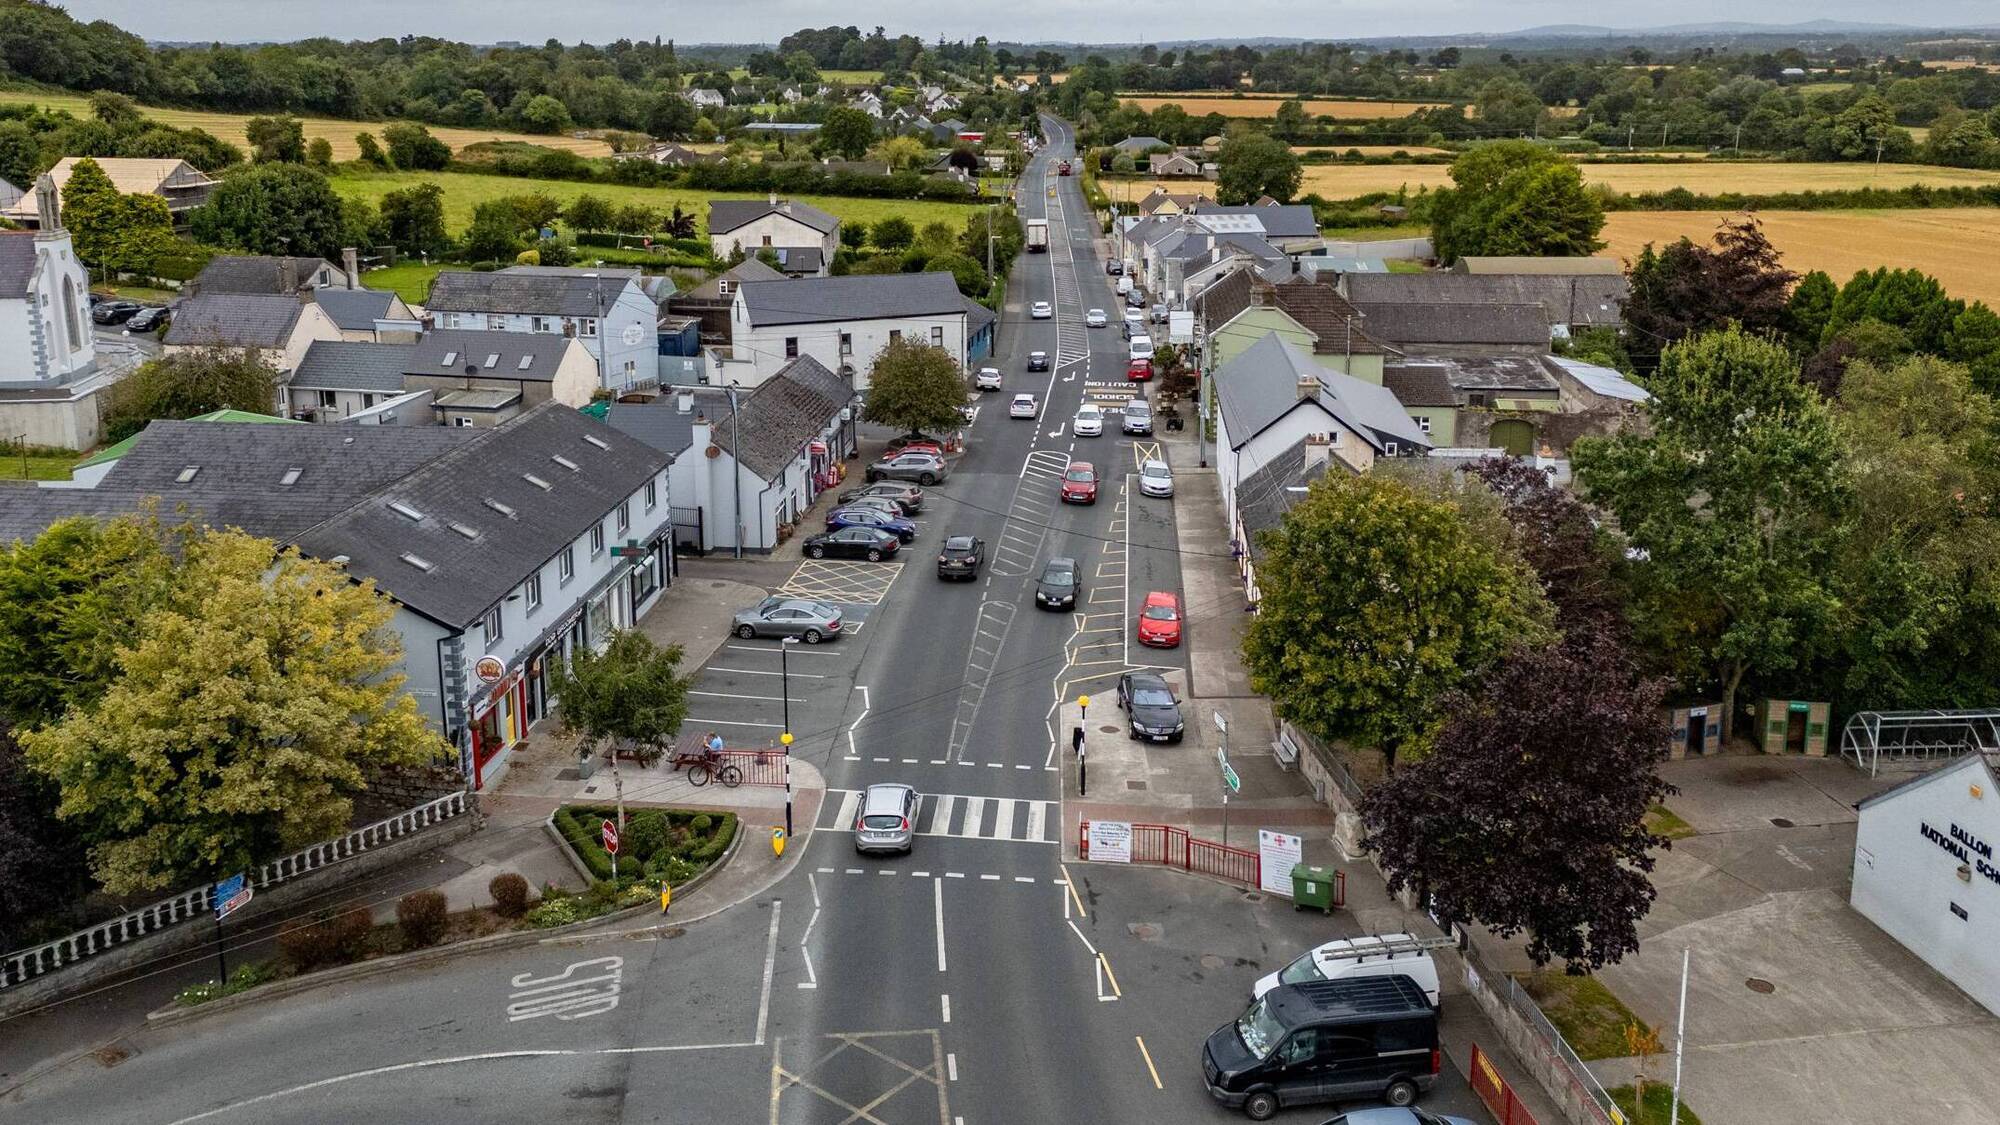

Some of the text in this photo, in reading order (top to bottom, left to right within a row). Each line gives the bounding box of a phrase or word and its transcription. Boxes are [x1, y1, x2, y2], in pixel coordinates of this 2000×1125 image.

[1921, 822, 2000, 885] NATIONAL SCH
[1950, 823, 1992, 860] BALLON
[506, 956, 623, 1022] STOP
